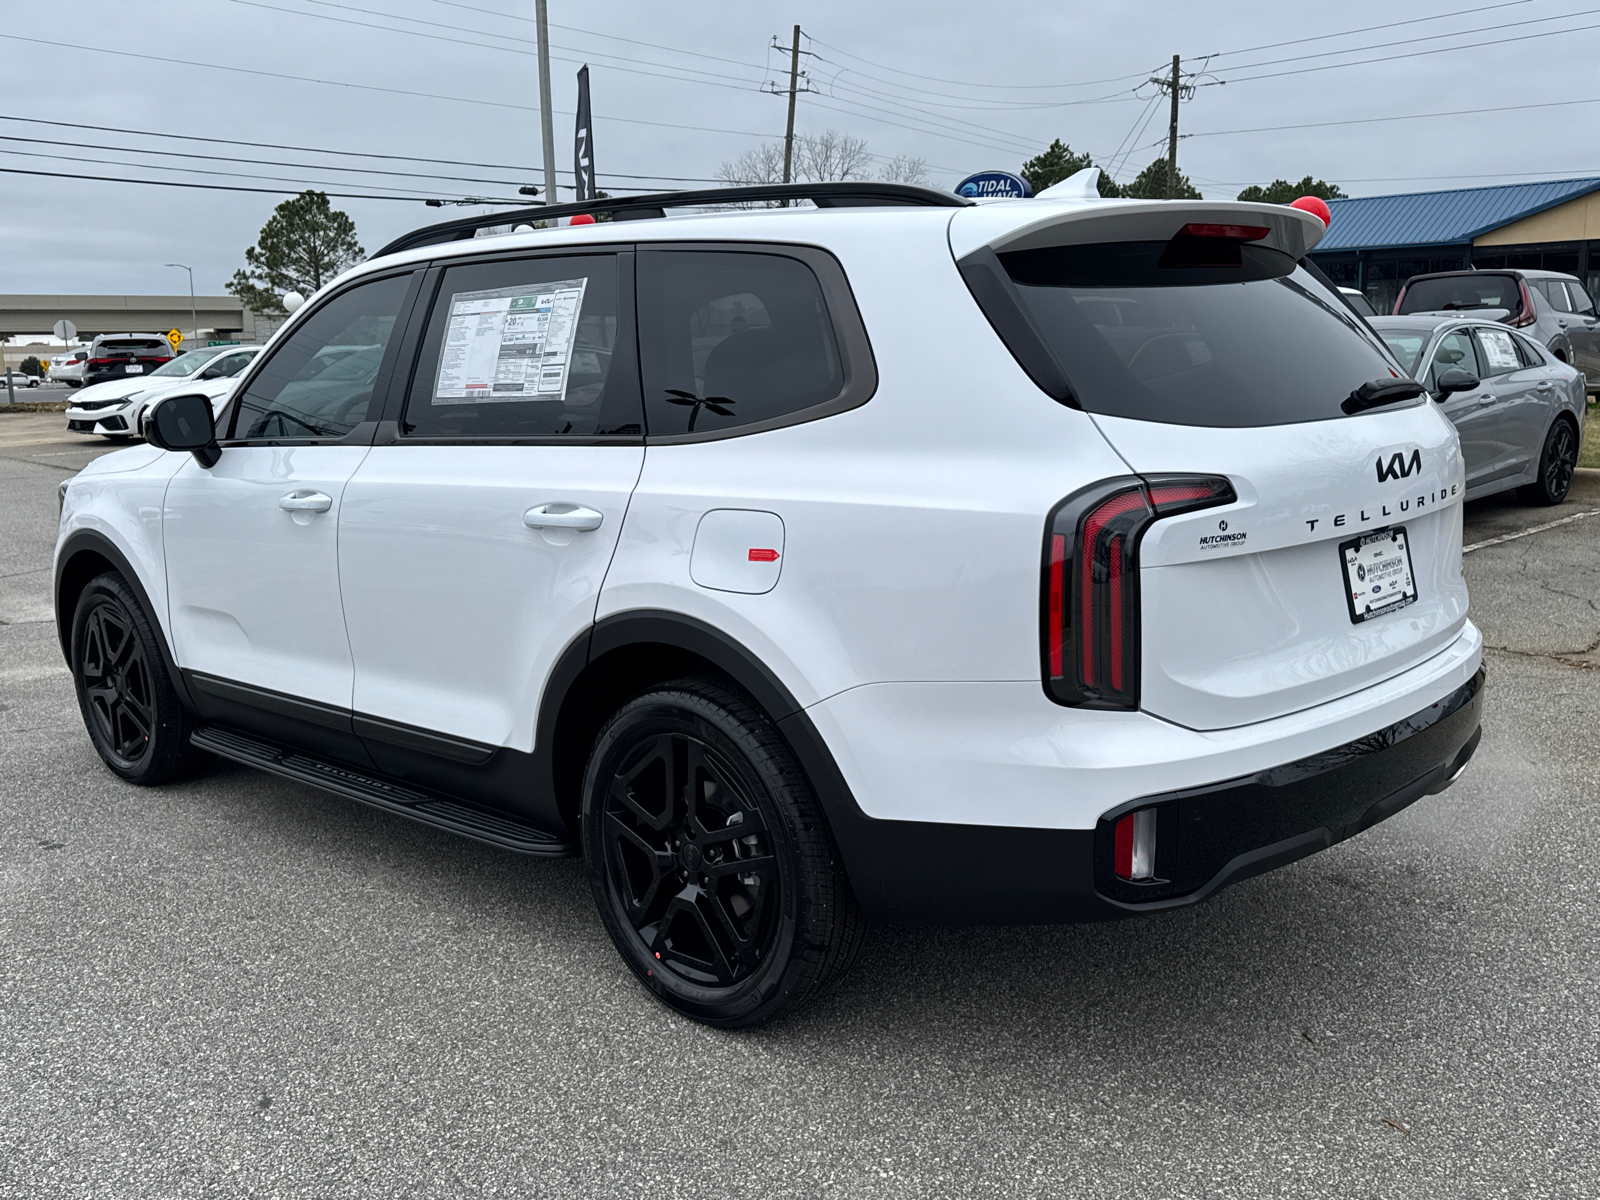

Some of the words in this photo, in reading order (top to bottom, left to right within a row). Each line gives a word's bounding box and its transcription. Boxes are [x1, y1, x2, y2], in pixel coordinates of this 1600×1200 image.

[978, 178, 1012, 193] TIDAL
[1376, 449, 1422, 483] KIA
[1306, 484, 1457, 532] TELLURIDE
[1200, 532, 1247, 544] HUTCHINSON
[1200, 541, 1230, 550] AUTOMOTIVE
[1366, 556, 1403, 576] HUTCHINSON
[1369, 571, 1392, 583] AUTOMOTIVE
[1391, 566, 1403, 576] GROUP
[315, 763, 393, 791] TELLURIDE
